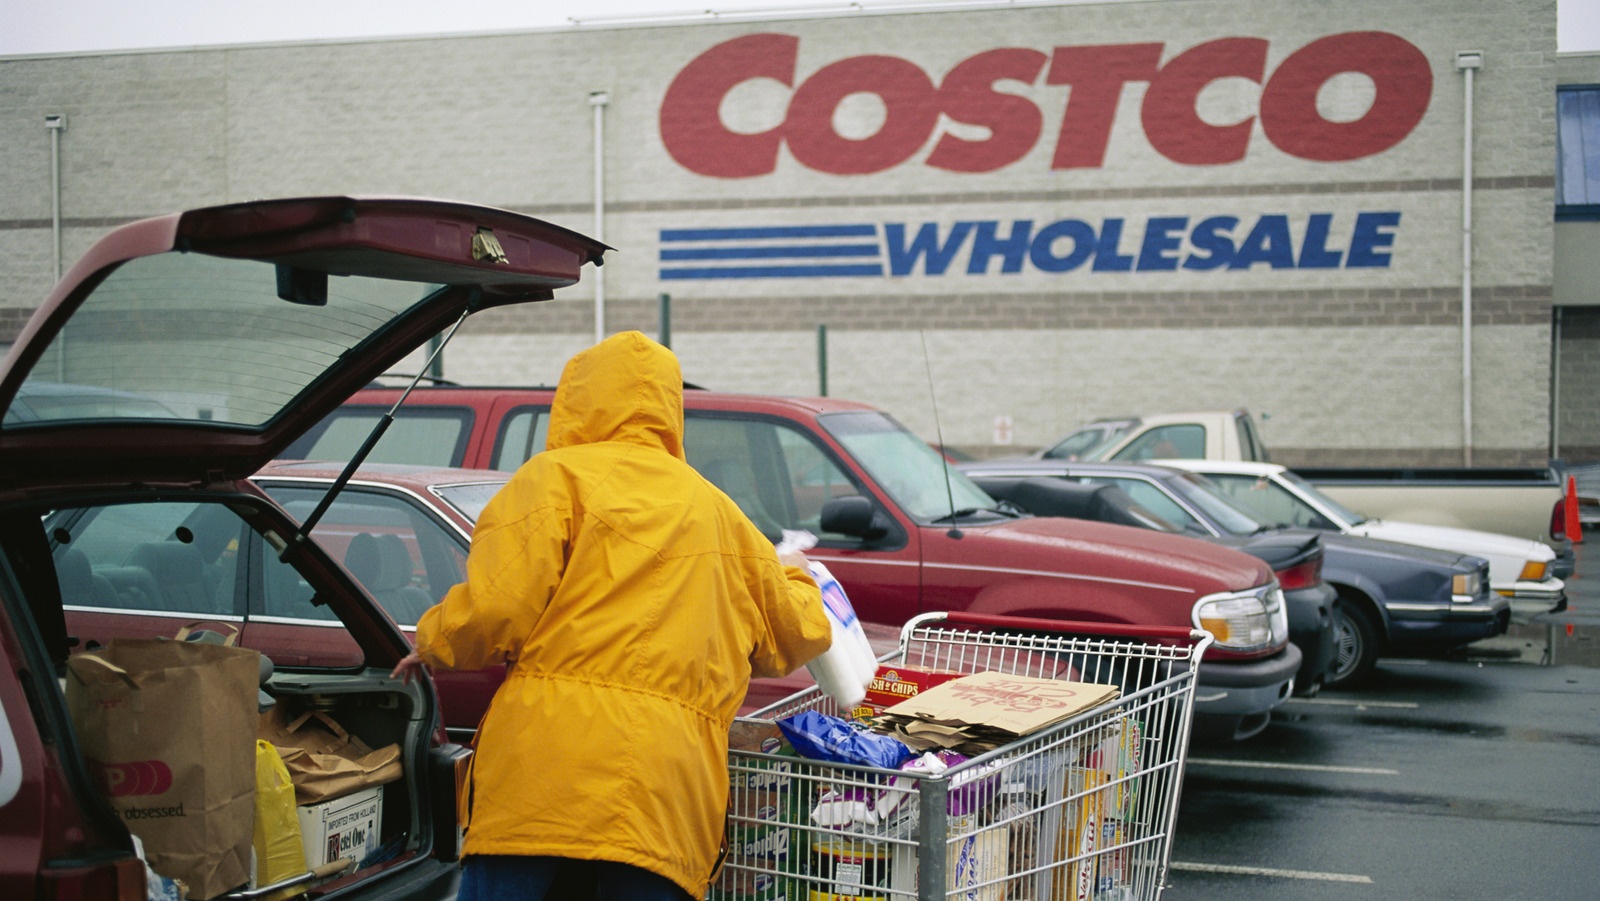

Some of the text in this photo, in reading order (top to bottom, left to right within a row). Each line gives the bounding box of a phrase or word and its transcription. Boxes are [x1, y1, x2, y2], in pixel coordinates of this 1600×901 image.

[659, 30, 1433, 178] COSTCO
[883, 211, 1400, 277] WHOLESALE
[868, 679, 885, 691] ISH
[891, 682, 919, 696] CHIPS
[750, 761, 792, 789] Ziploc
[124, 802, 187, 819] obsessed.
[328, 804, 376, 831] IMPORTED FROM HOLLAND
[352, 827, 366, 847] One
[745, 827, 790, 856] Ziploc
